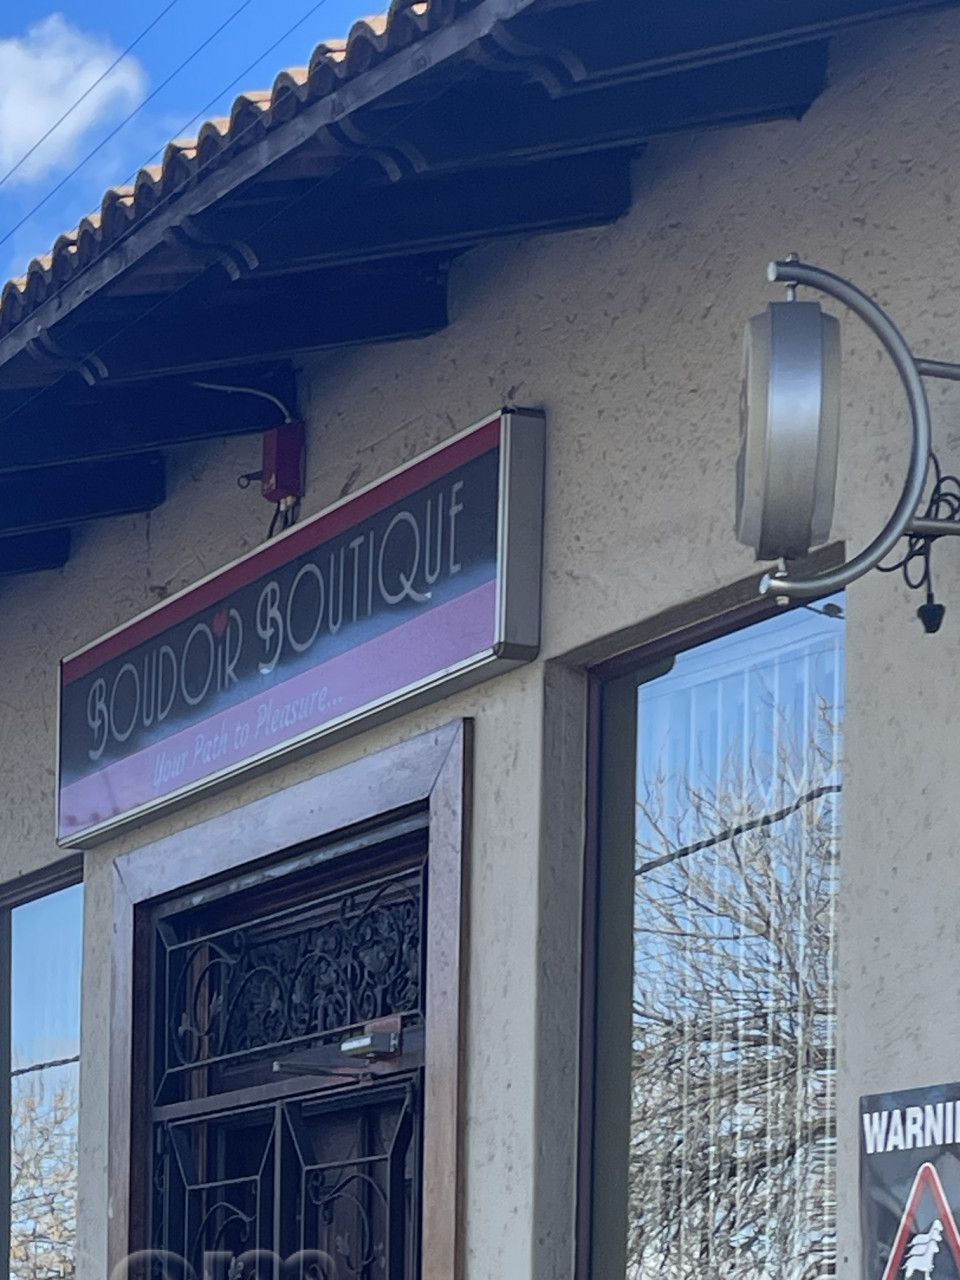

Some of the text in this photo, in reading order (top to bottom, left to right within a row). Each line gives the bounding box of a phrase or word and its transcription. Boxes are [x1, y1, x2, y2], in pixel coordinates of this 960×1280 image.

[86, 480, 464, 762] BOUDOIR BOUTIQUE
[153, 750, 190, 793] Your
[192, 719, 229, 767] Path
[234, 720, 250, 750] to
[862, 1100, 960, 1154] WARNI
